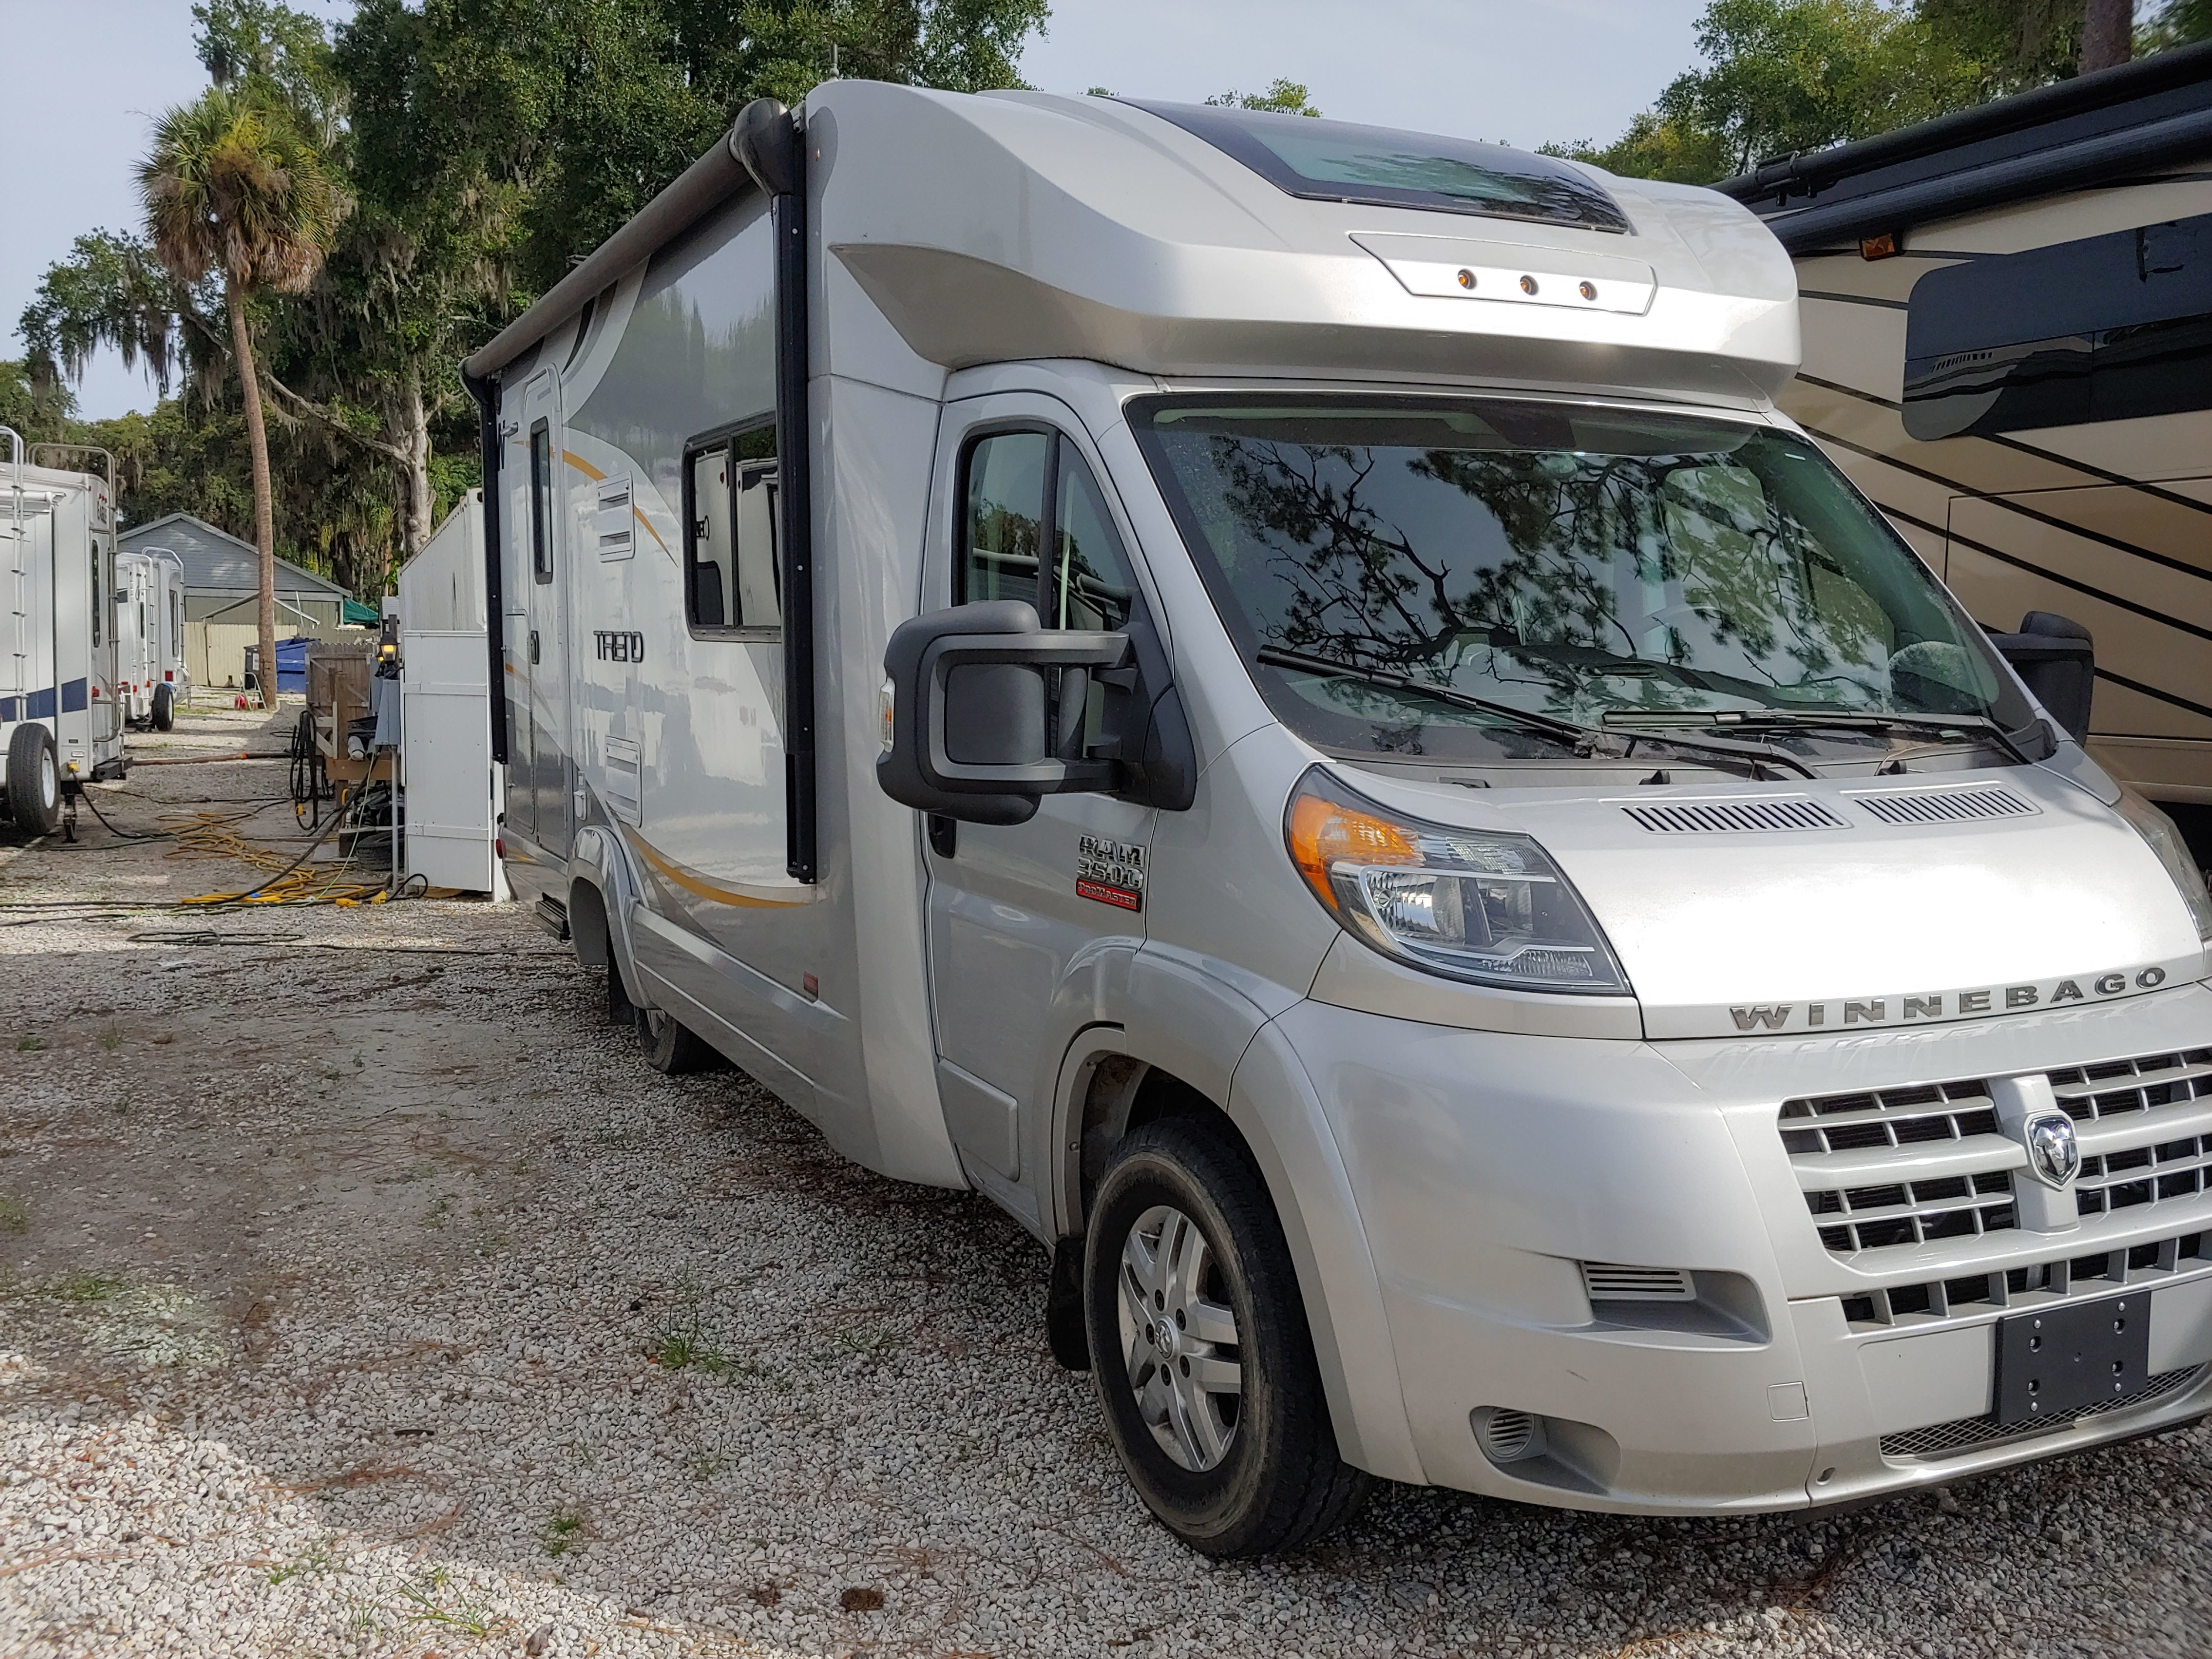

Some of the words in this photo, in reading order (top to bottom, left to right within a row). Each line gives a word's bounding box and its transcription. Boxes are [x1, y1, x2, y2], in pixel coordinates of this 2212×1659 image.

[593, 630, 644, 663] TREND
[1079, 833, 1146, 868] RAM
[1077, 857, 1144, 890] 3500
[1729, 967, 2166, 1030] WINNEBAGO
